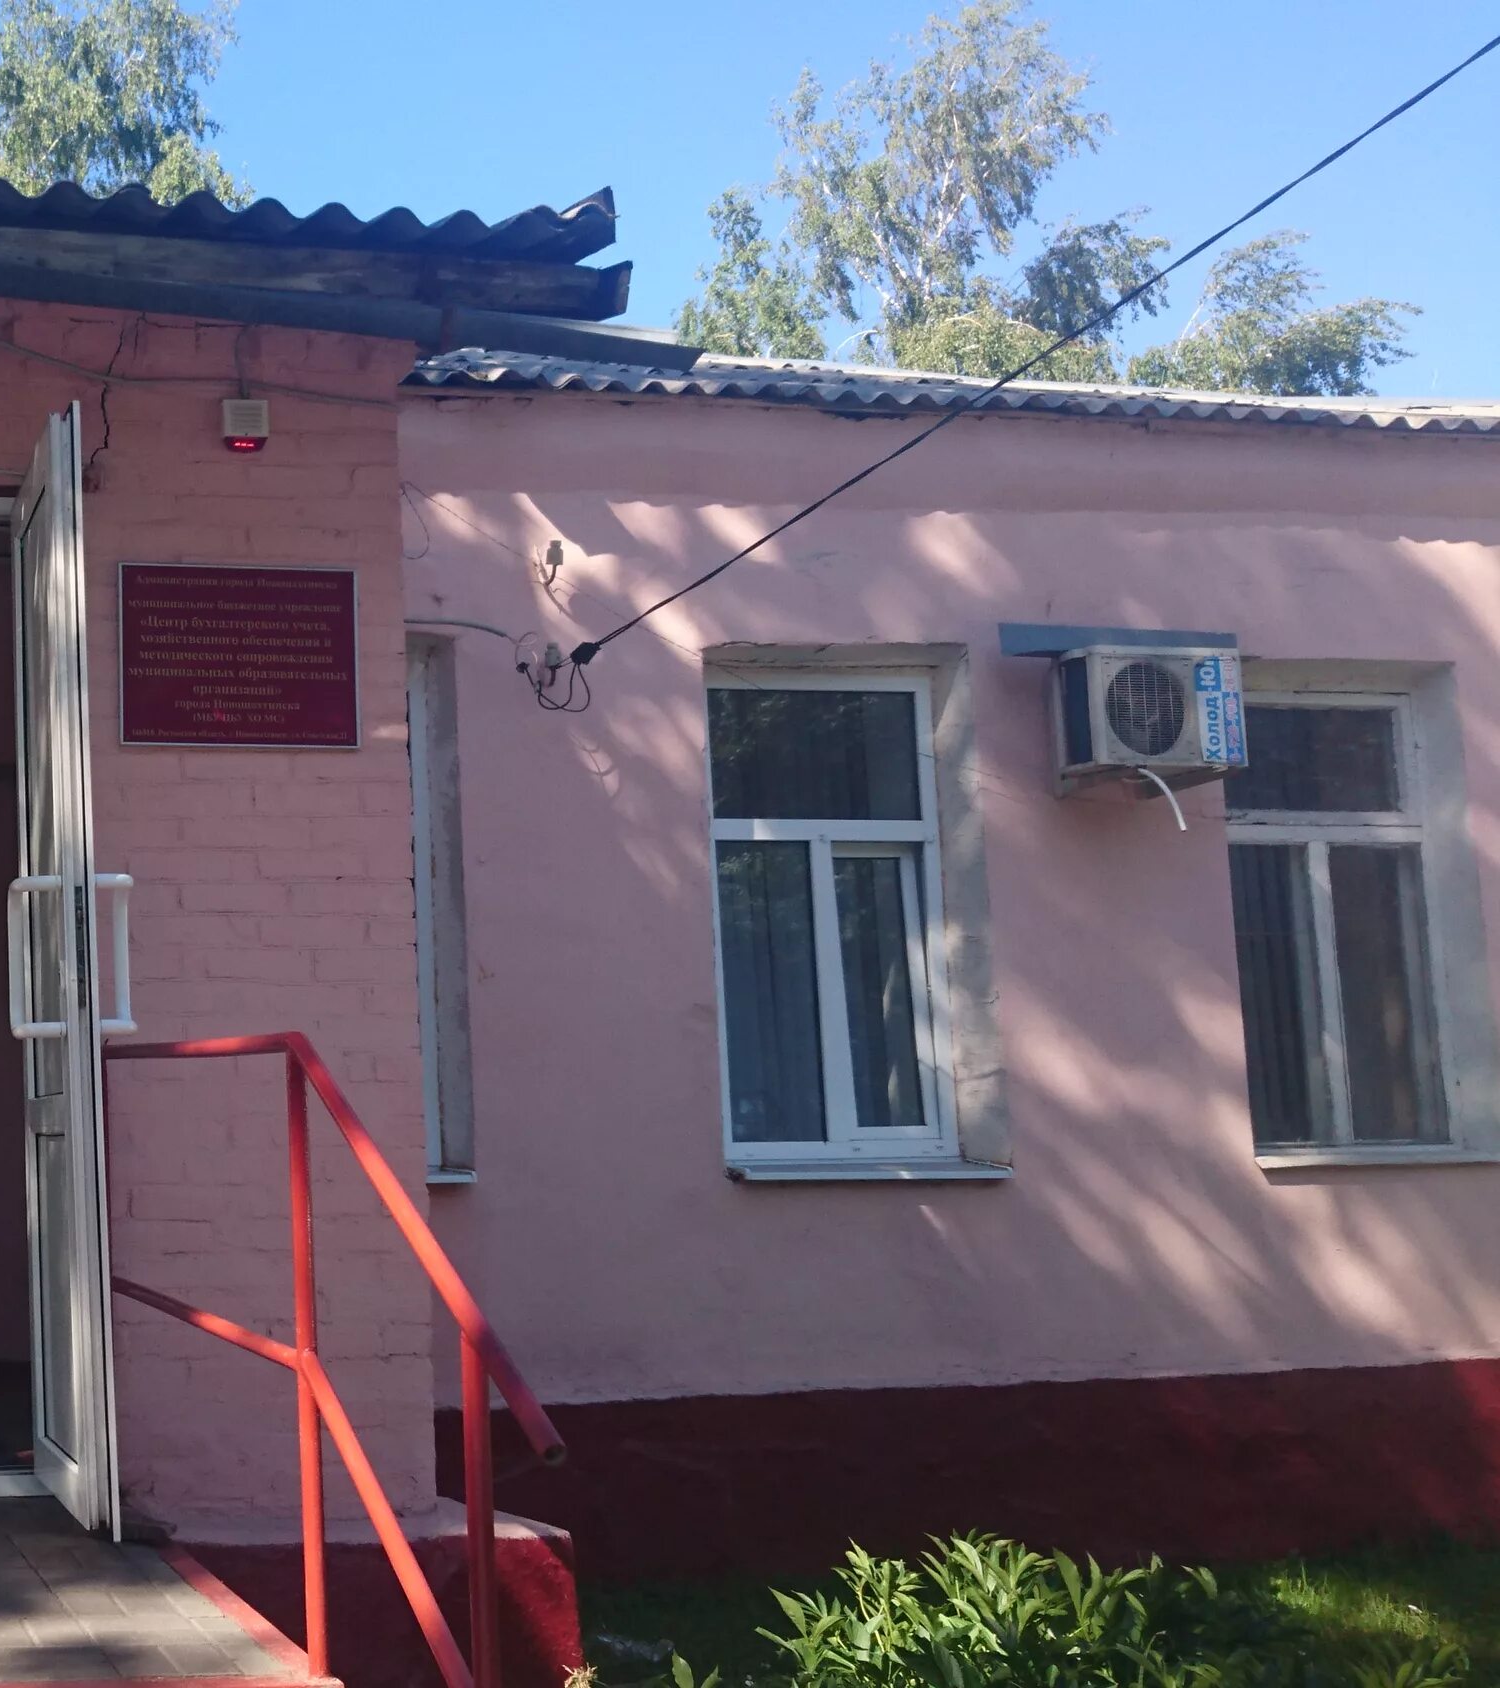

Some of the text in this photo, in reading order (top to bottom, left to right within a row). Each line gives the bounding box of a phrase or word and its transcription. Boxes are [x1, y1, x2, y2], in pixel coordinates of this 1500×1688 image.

[135, 574, 219, 588] Администрация
[220, 577, 254, 589] города
[128, 599, 342, 614] муниципальное бюджетное учреждение
[140, 615, 332, 634] «Центр бухгалтерского учета,
[140, 631, 332, 647] хозяйственного обеспечения и
[140, 649, 333, 665] методического сопровождения
[128, 667, 348, 682] муниципальных образовательных
[192, 683, 282, 697] организаций»
[175, 700, 211, 711] города
